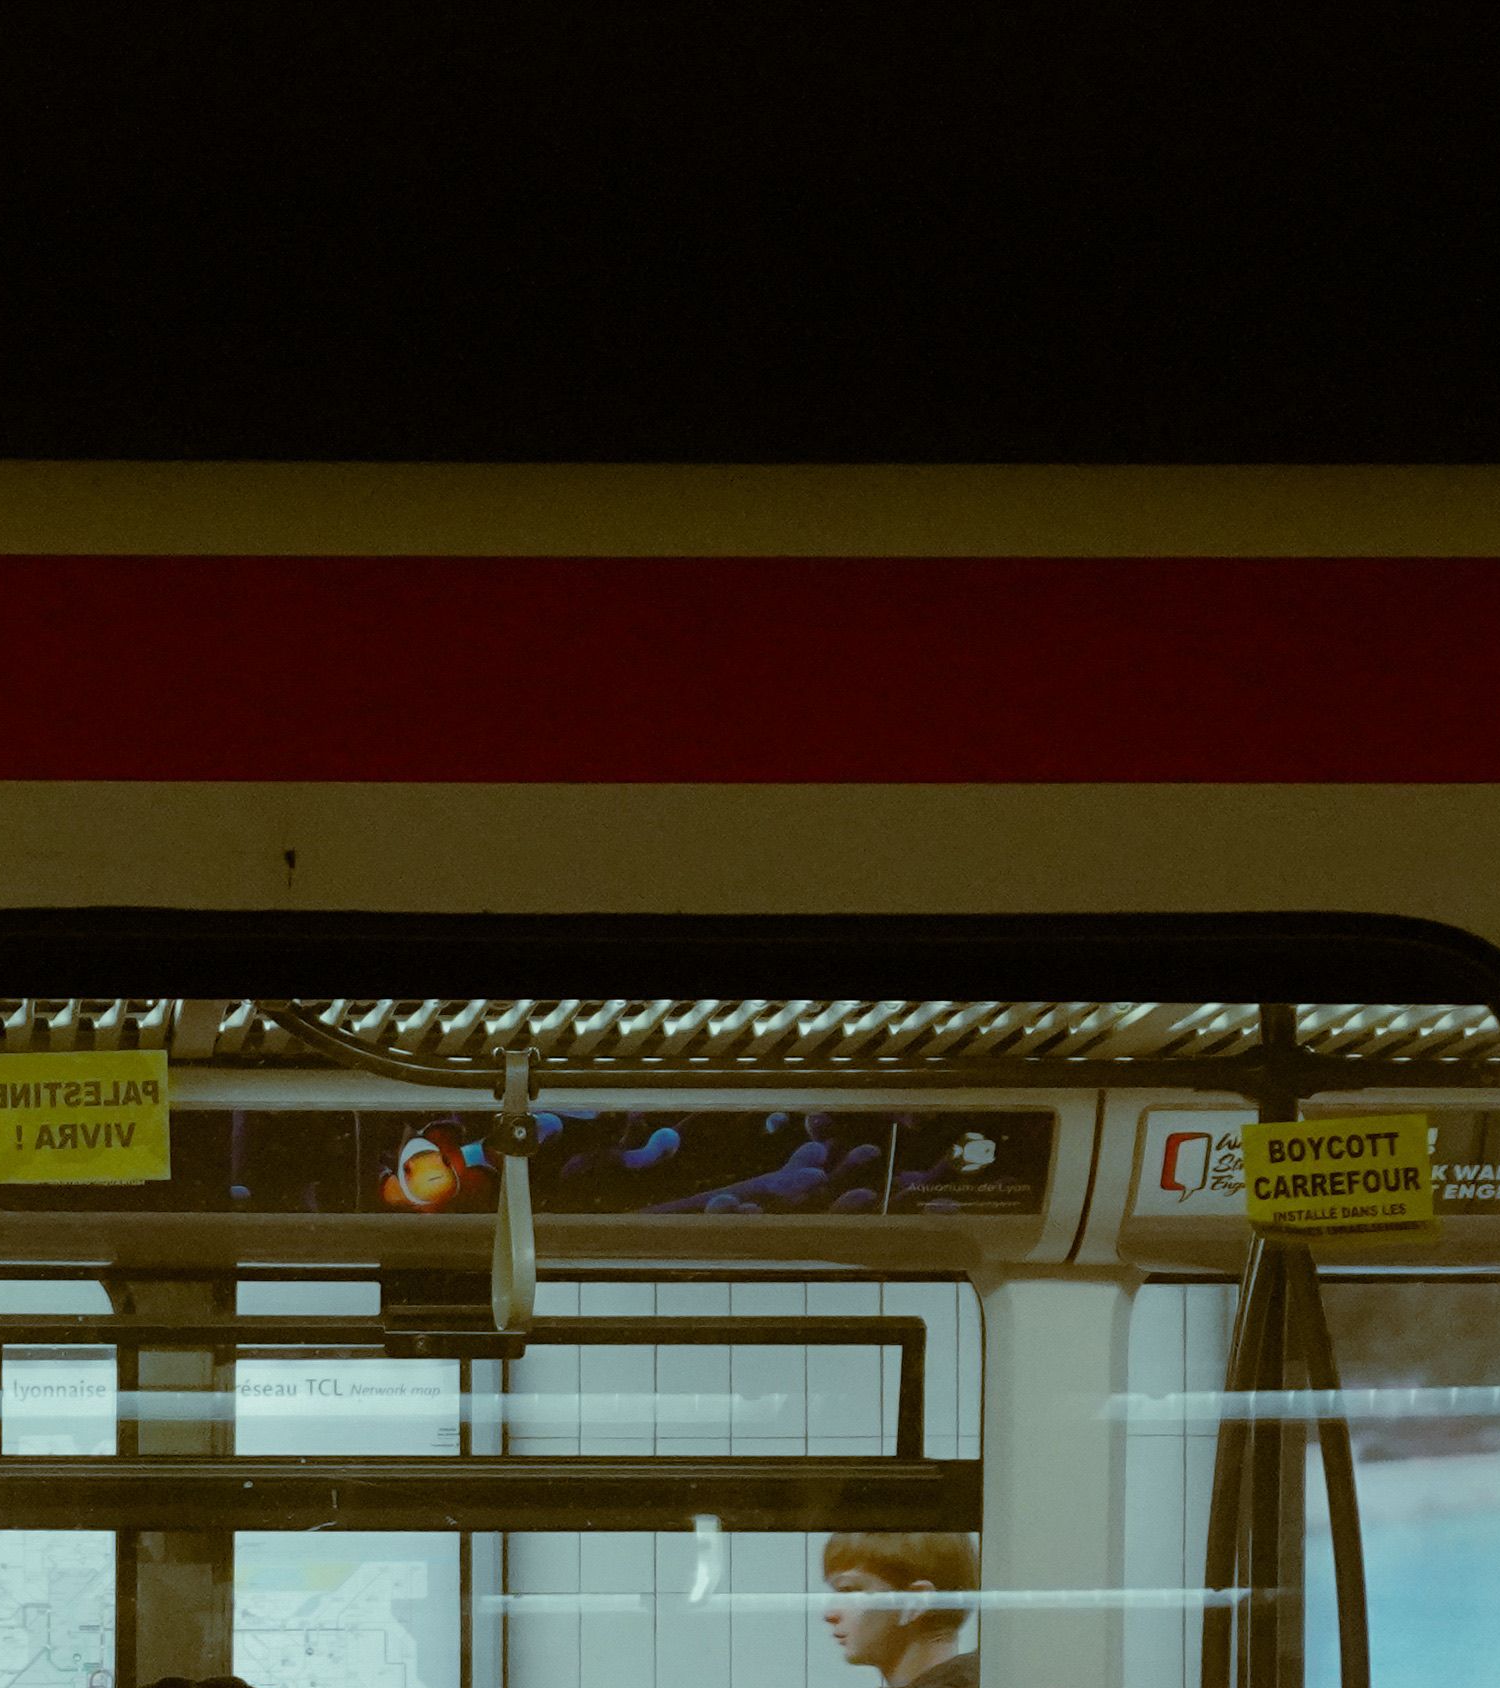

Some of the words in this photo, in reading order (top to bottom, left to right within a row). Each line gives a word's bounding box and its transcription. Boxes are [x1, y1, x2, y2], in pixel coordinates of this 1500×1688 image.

[1268, 1132, 1400, 1164] BOYCOTT
[909, 1183, 974, 1193] Aquarium
[999, 1184, 1031, 1195] Lyon
[1254, 1166, 1422, 1202] CARREFOUR
[1342, 1206, 1379, 1219] DANS
[1382, 1203, 1407, 1217] LES
[13, 1380, 107, 1401] lyonnaise
[306, 1378, 343, 1396] TCL
[350, 1383, 407, 1396] Network
[410, 1386, 441, 1398] map
